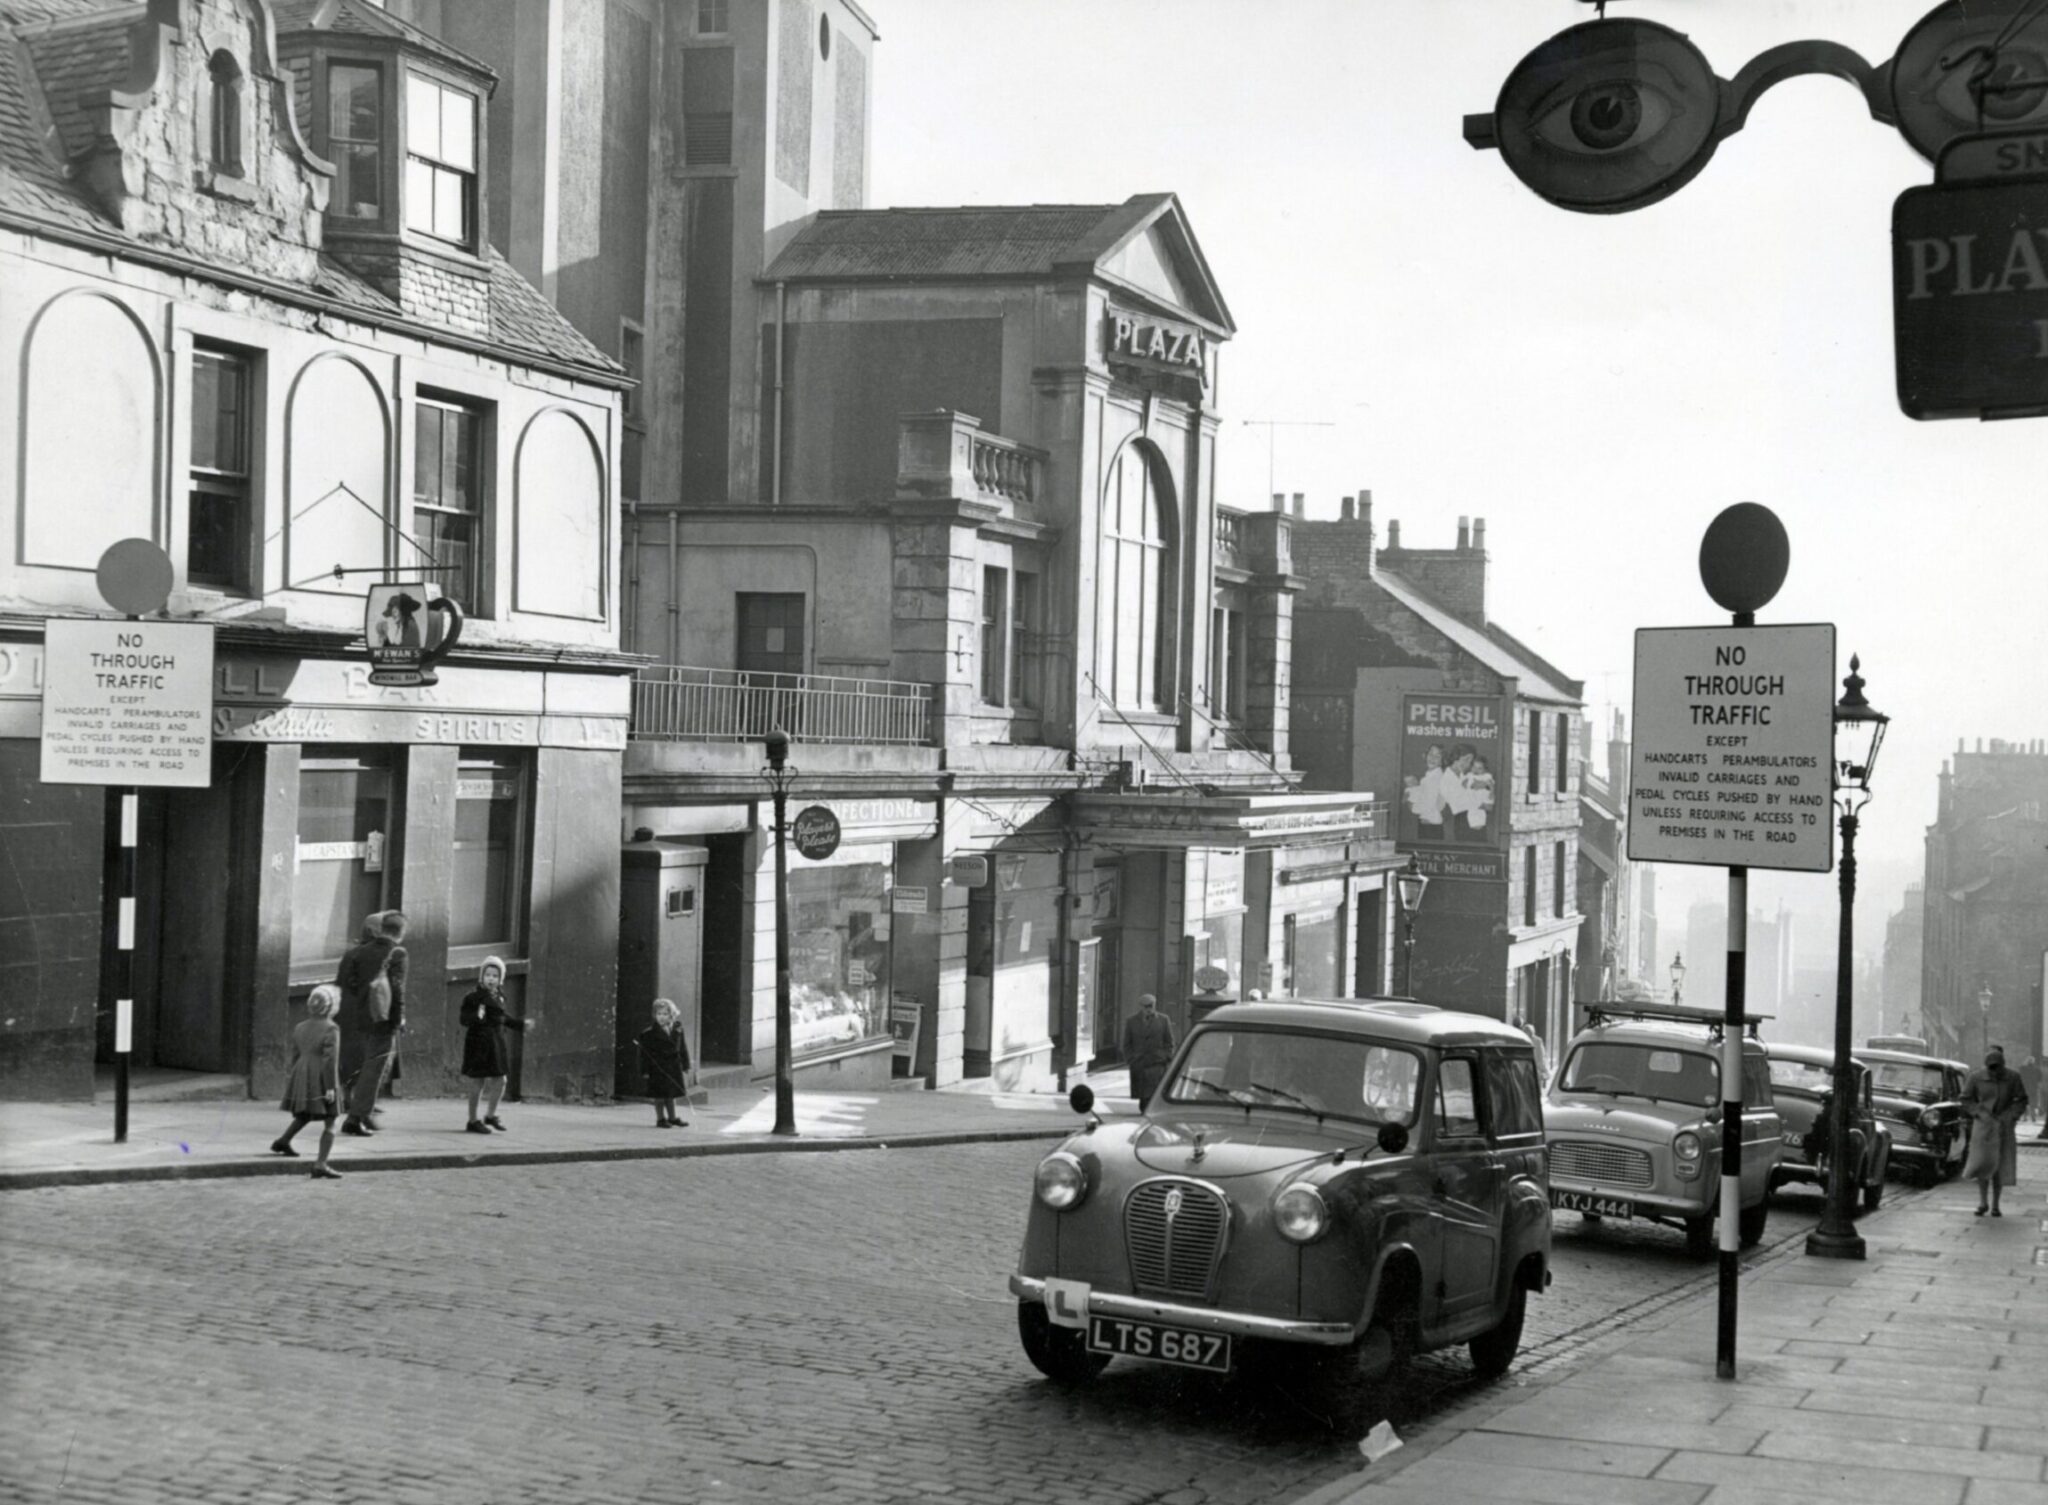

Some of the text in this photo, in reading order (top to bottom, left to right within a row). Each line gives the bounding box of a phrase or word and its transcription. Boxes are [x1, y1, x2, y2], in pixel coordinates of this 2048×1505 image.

[1906, 229, 2048, 299] PLA
[1114, 317, 1203, 368] PLAZA
[117, 633, 143, 648] NO
[90, 653, 174, 669] THROUGH
[1716, 646, 1746, 666] NO
[95, 673, 164, 689] TRAFFIC
[1684, 675, 1784, 696] THROUGH
[110, 695, 146, 704] EXCEPT
[54, 707, 201, 719] HANDCARTS PERAMBULATORS
[1410, 704, 1495, 724] PERSIL
[1690, 705, 1771, 725] TRAFFIC
[67, 720, 187, 731] INVALID CARRIAGES AND
[415, 715, 525, 742] SPIRITS
[1407, 724, 1498, 739] washes whiter!
[46, 732, 205, 745] PEDAL CYCLES PUSHED BY HAND
[1706, 736, 1748, 747] EXCEPT
[52, 745, 200, 757] UNLESS REQUIRING ACCESS TO
[68, 758, 184, 770] PREMISES IN THE ROAD
[1645, 753, 1817, 767] HANDCARTS PERAMBULATORS
[1659, 771, 1800, 786] INVALID CARRIAGES AND
[1635, 788, 1823, 806] PEDAL CYCLES PUSHED BY HAND
[1642, 806, 1816, 825] UNLESS REQUIRING ACCESS TO
[1659, 825, 1797, 843] PREMISES IN THE ROAD
[1444, 864, 1497, 876] MERCHANT
[1558, 1191, 1628, 1217] KYJ 444
[1055, 1290, 1078, 1319] L
[1094, 1319, 1223, 1364] LTS 687
